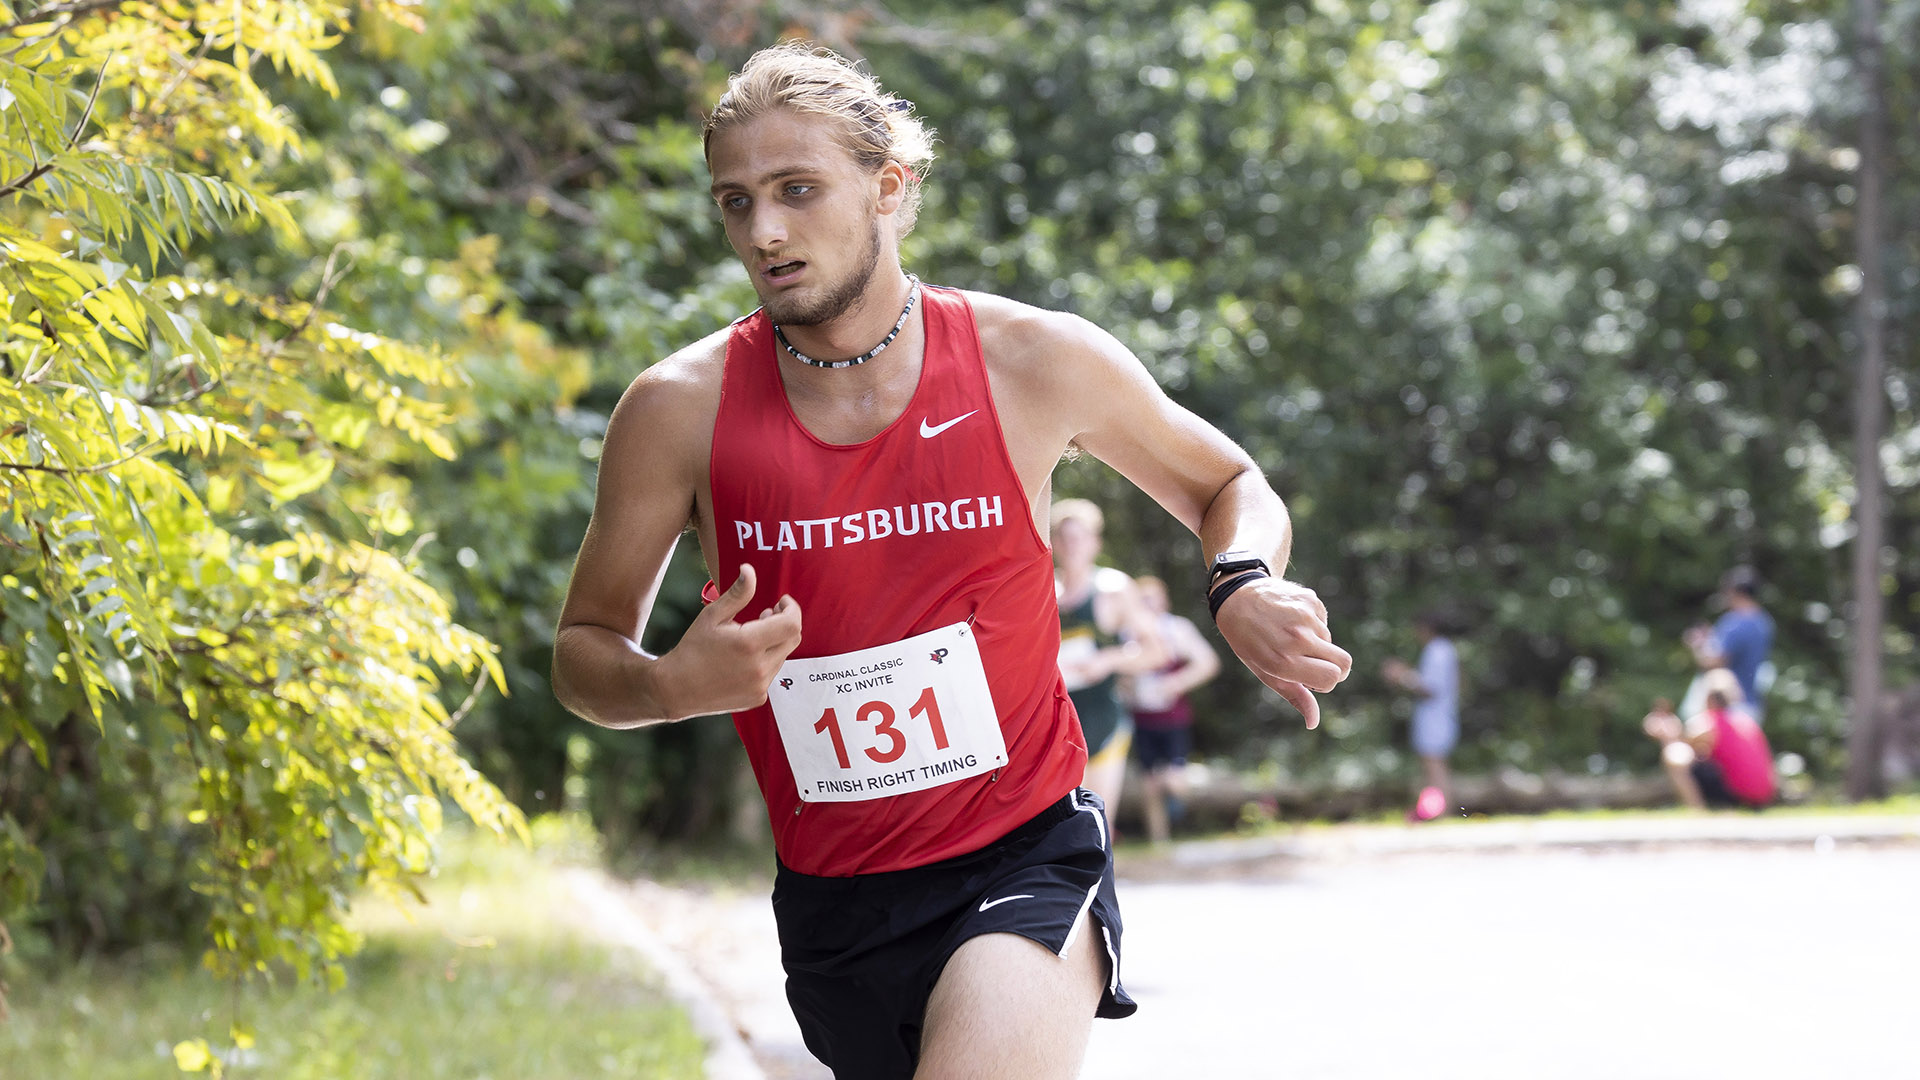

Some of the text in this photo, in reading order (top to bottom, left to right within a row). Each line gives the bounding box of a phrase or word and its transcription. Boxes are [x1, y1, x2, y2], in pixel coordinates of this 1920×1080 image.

[734, 495, 1004, 551] PLATTSBURGH
[808, 657, 904, 683] CARDINAL CLASSIC
[836, 674, 894, 694] XC INVITE
[813, 686, 950, 769] 131
[816, 754, 978, 794] FINISH RIGHT TIMING
